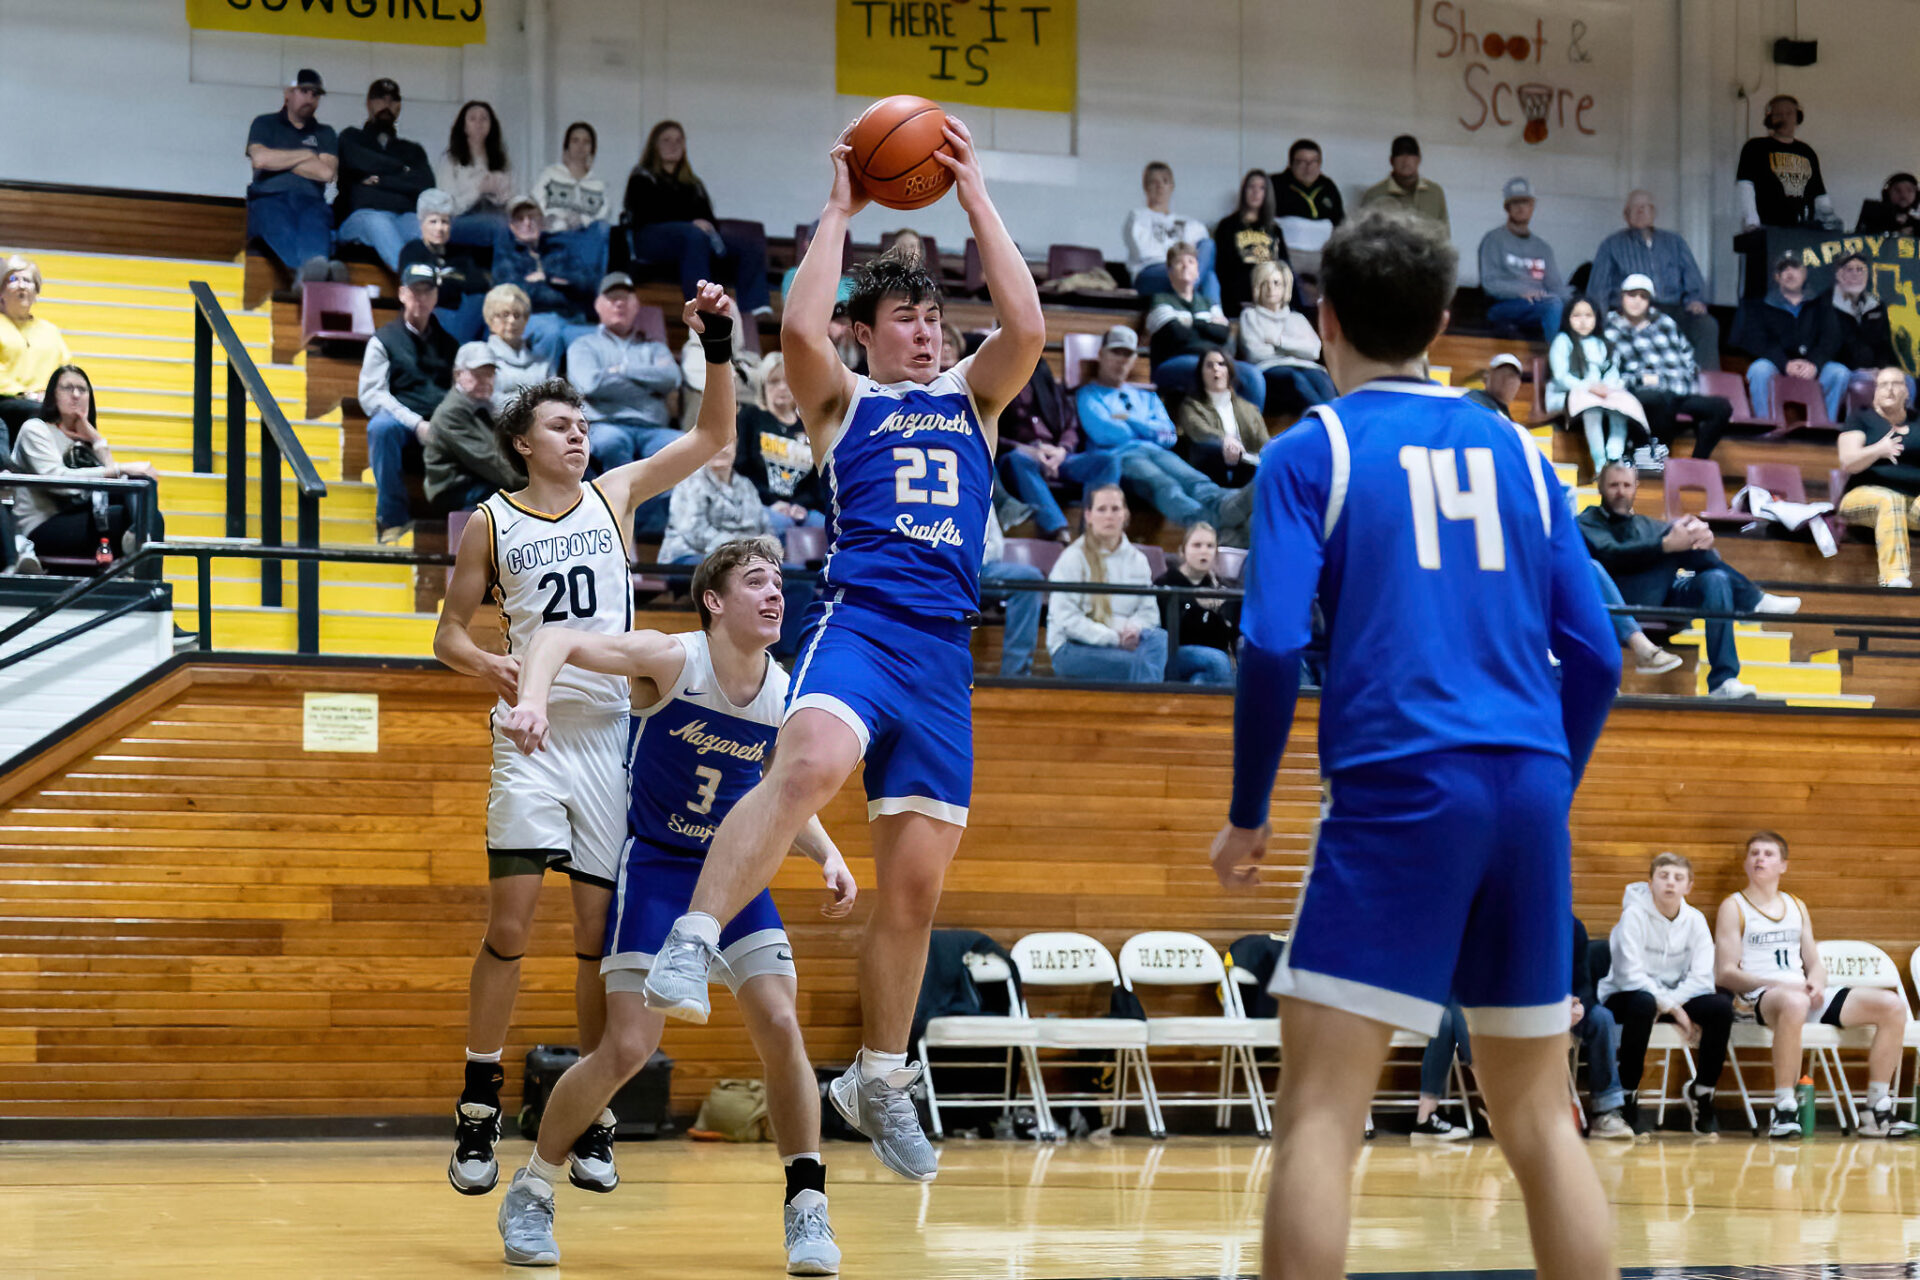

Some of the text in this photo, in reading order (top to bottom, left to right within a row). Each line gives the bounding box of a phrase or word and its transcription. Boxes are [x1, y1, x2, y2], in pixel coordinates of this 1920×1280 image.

[853, 0, 1051, 46] THERE IT
[1567, 19, 1593, 63] &
[929, 44, 989, 86] IS
[1802, 236, 1884, 267] APPY
[869, 406, 973, 438] Nazareth
[893, 447, 959, 507] 23
[1399, 445, 1506, 572] 14
[506, 528, 612, 575] COWBOYS
[890, 513, 963, 549] Swifts
[537, 565, 597, 624] 20
[669, 719, 767, 762] Nazareth
[686, 764, 722, 815] 3
[1030, 949, 1096, 969] HAPPY
[1138, 947, 1203, 967] HAPPY
[1773, 948, 1790, 971] 11
[1822, 955, 1882, 976] HAPPY
